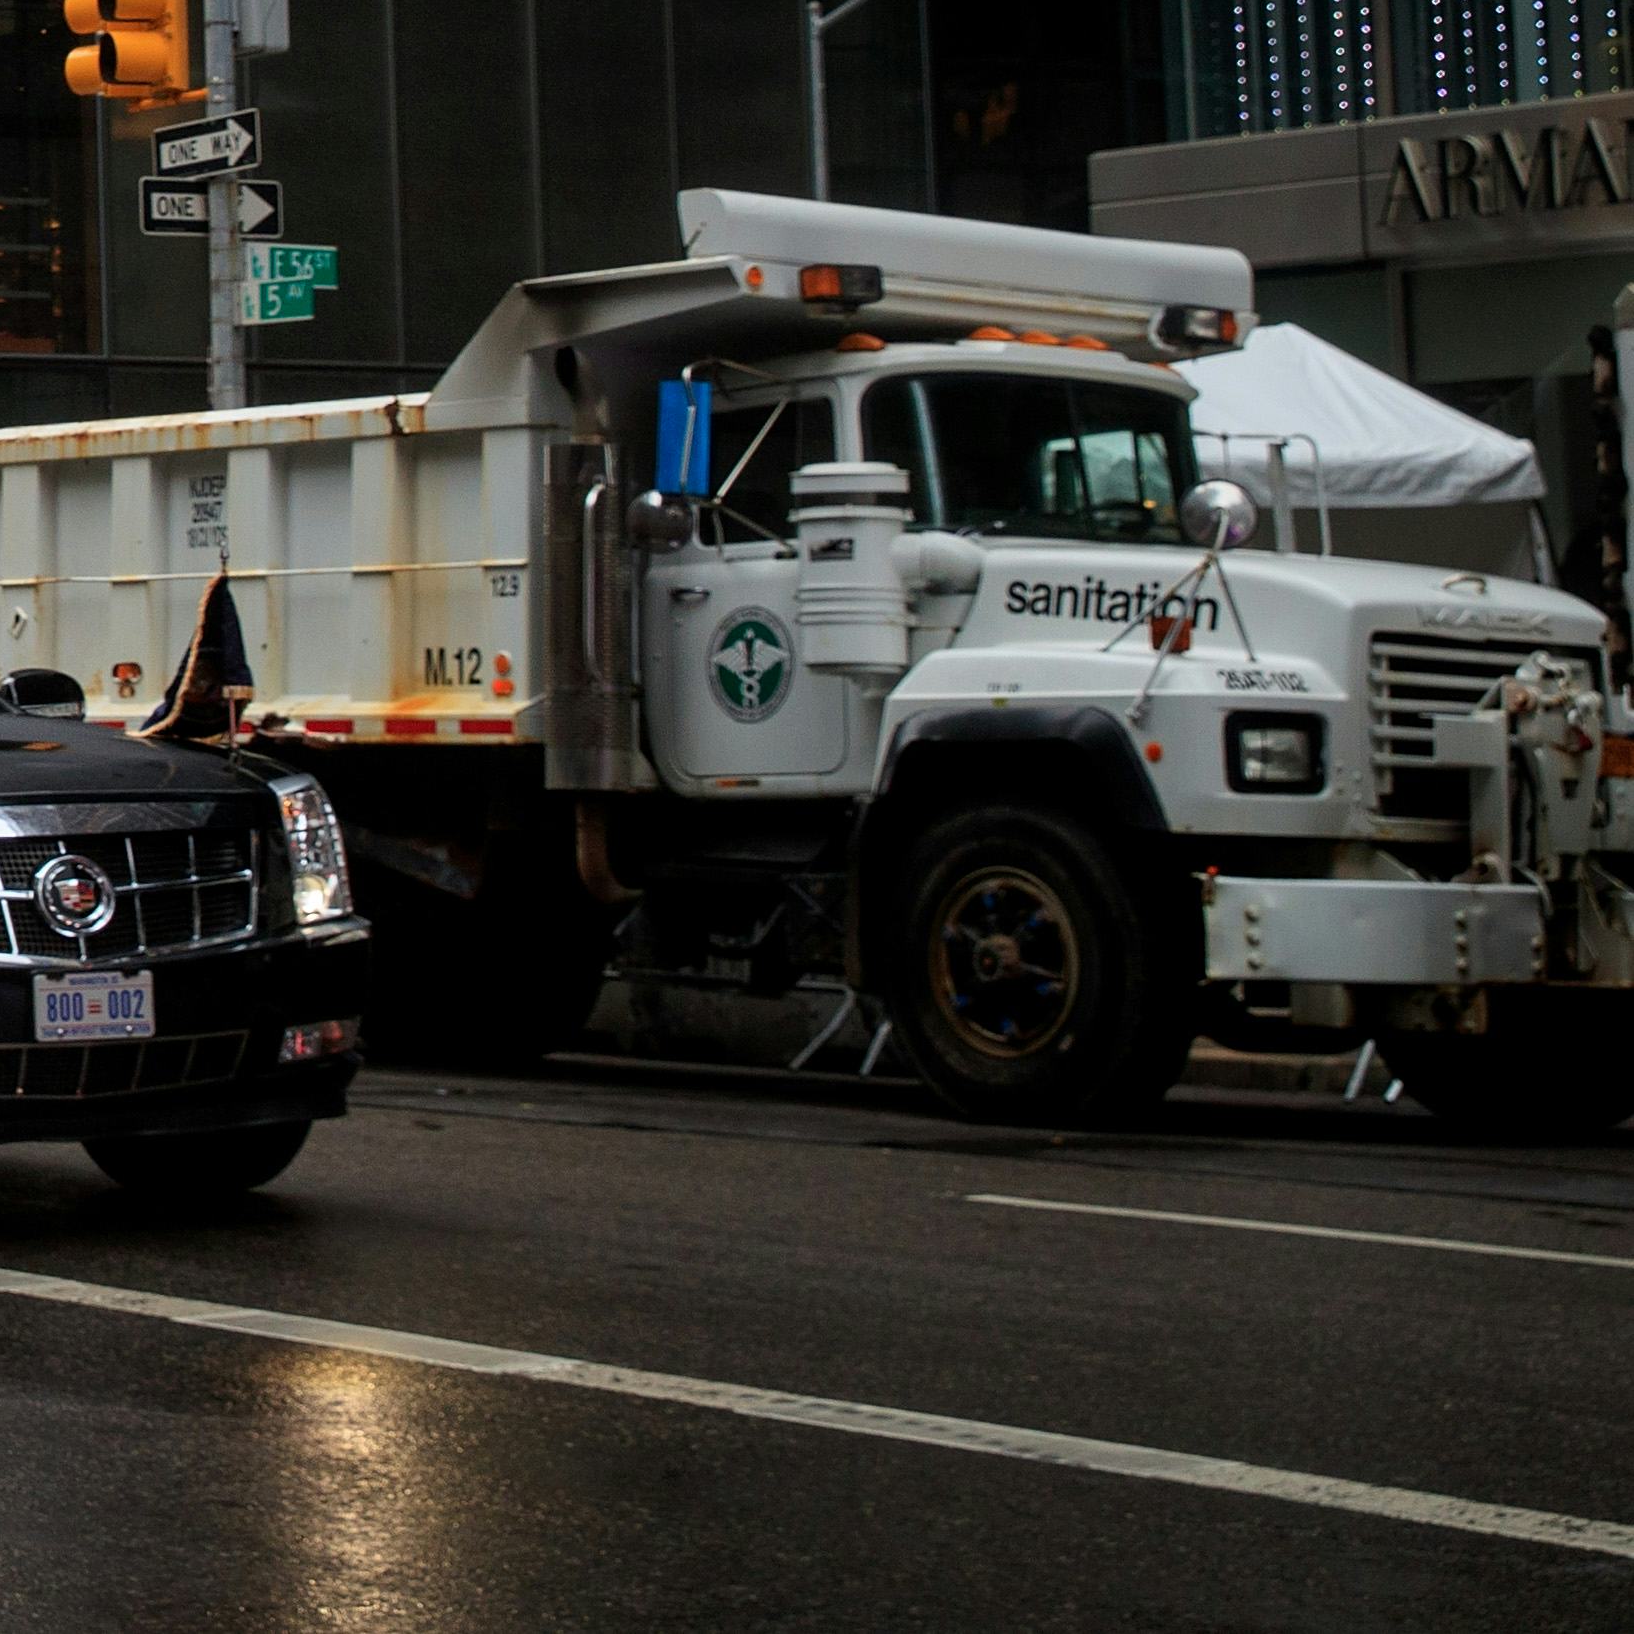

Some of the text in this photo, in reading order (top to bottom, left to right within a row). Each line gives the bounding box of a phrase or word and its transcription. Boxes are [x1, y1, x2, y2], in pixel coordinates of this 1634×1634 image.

[168, 131, 242, 164] ONE WAY
[1384, 117, 1634, 226] ARMA
[156, 195, 195, 217] ONE
[275, 251, 284, 279] E
[292, 251, 315, 280] 56
[268, 284, 282, 316] 5
[1007, 575, 1220, 631] sanitation
[424, 647, 483, 686] M.12
[47, 989, 145, 1023] 800 002
